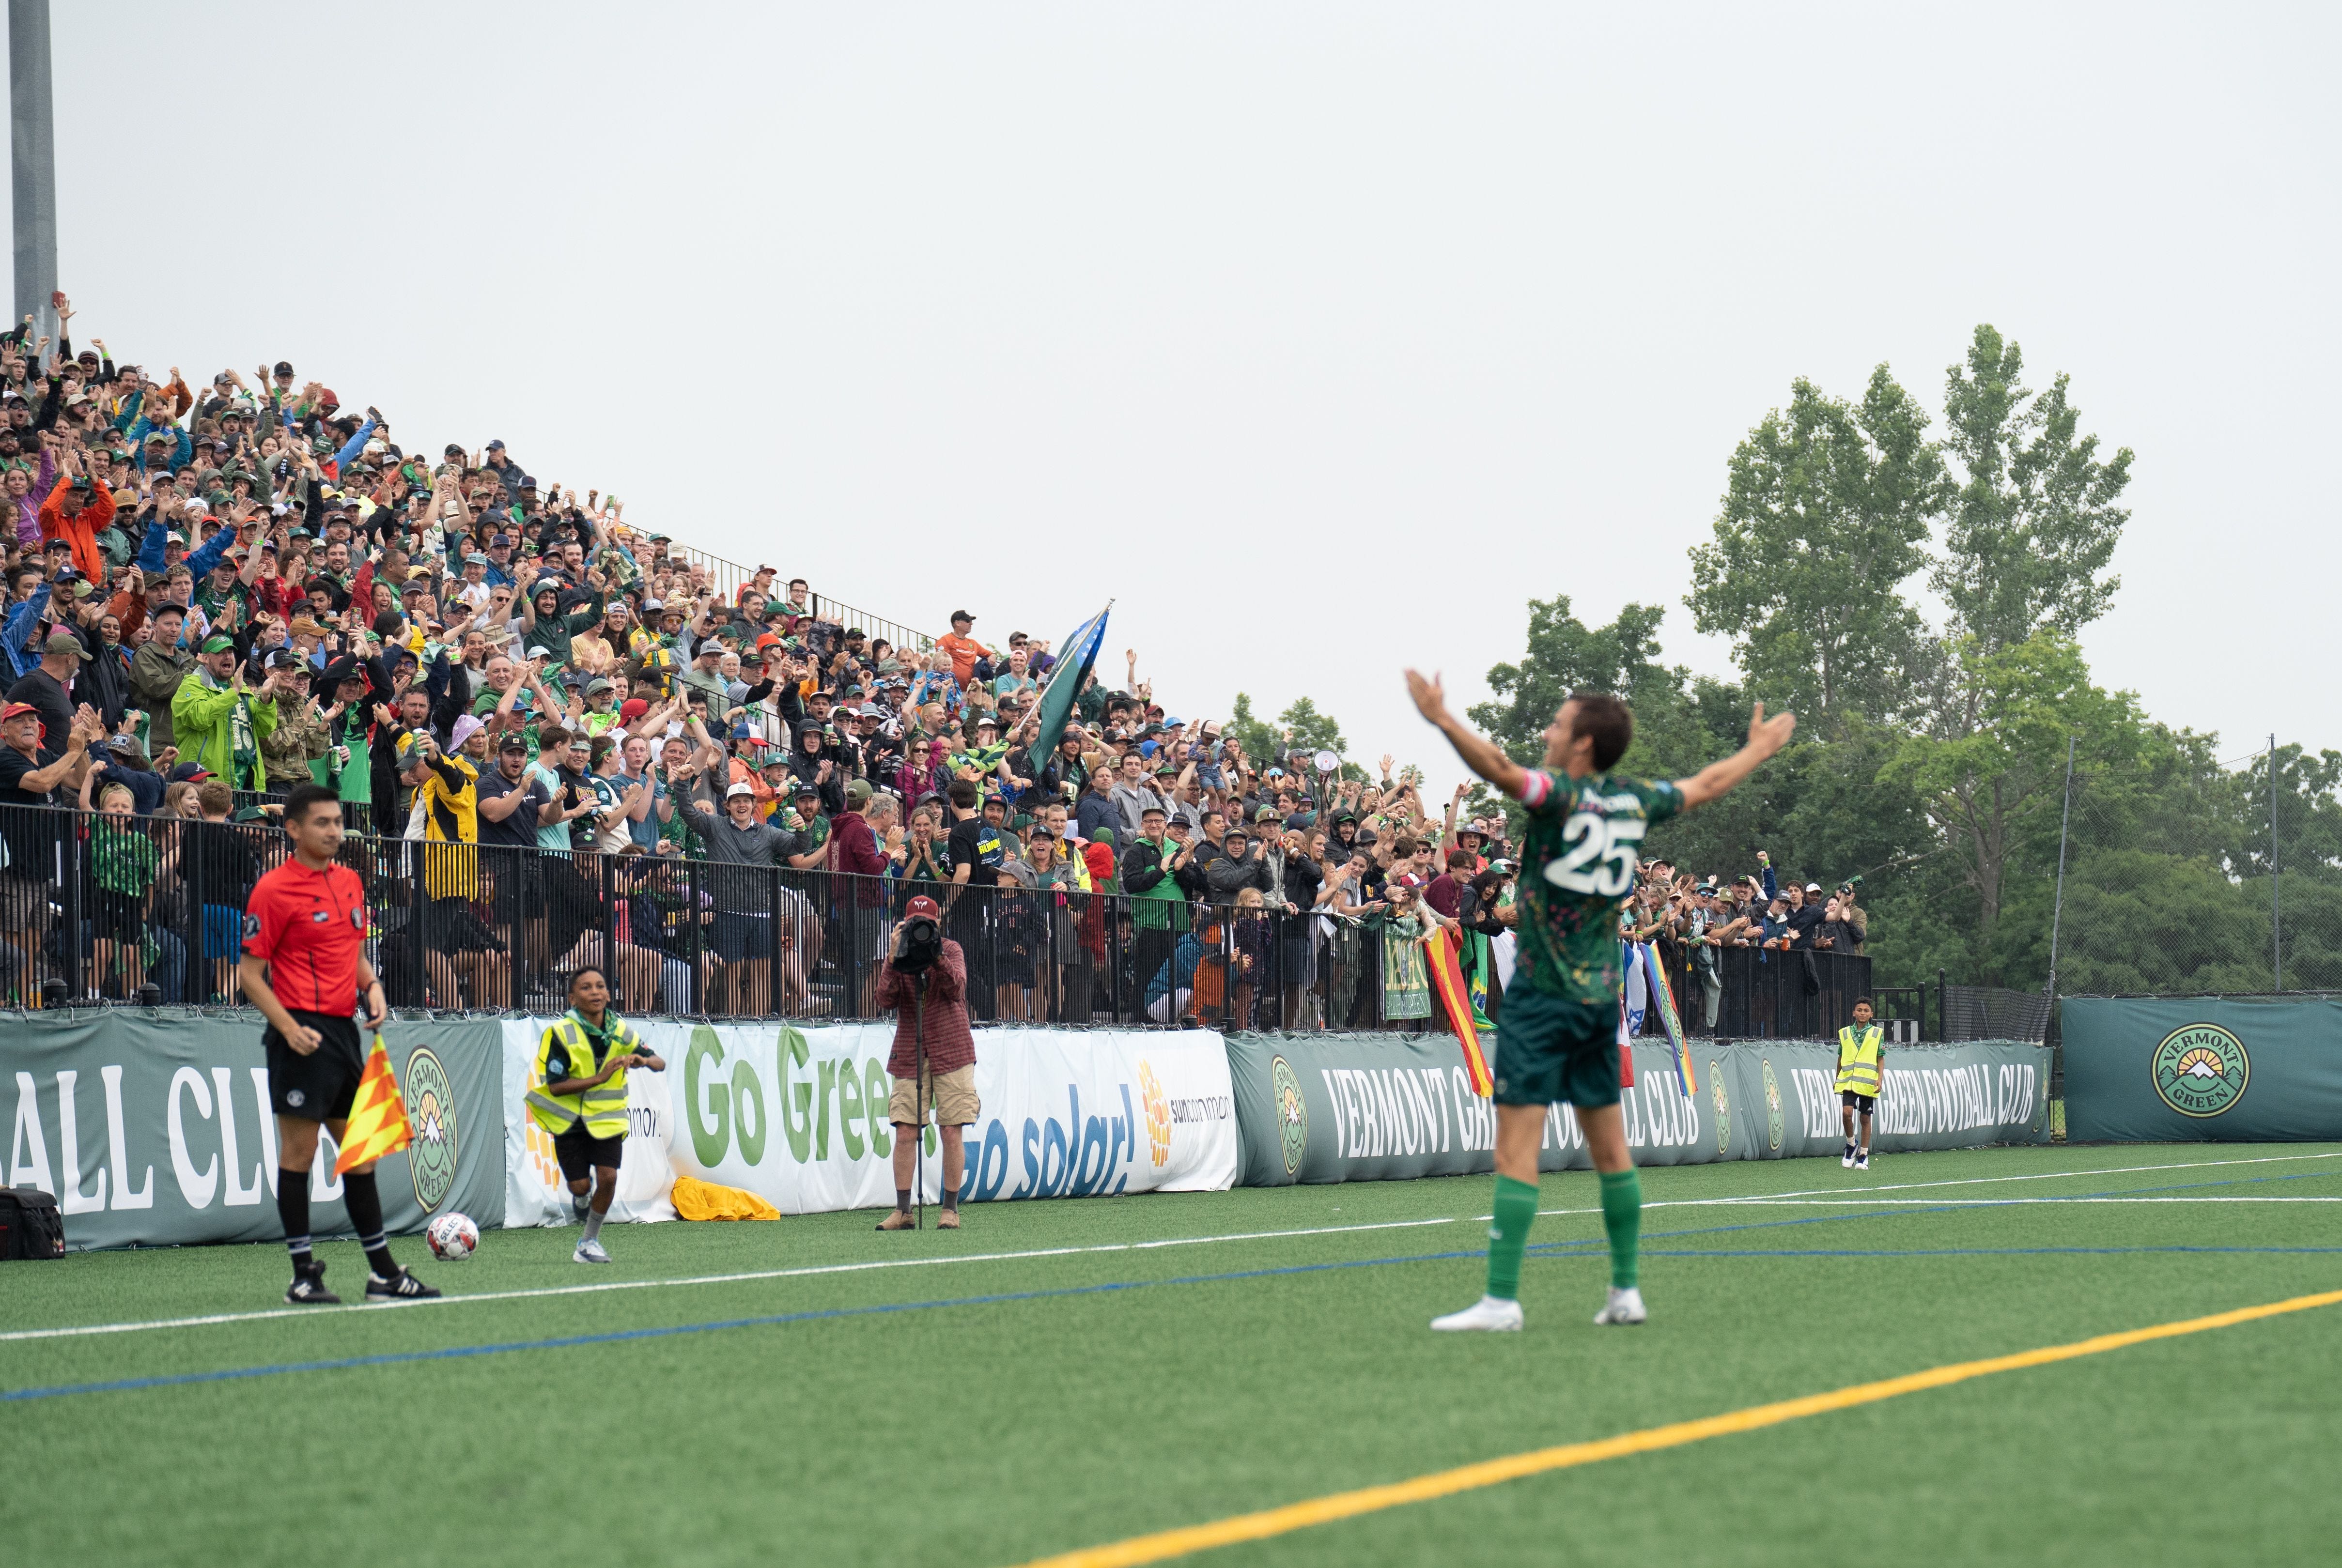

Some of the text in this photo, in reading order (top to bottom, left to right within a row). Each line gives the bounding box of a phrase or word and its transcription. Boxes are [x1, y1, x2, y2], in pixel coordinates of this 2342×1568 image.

[1544, 813, 1646, 896] 25
[2164, 1032, 2239, 1063] VERMONT
[410, 1064, 450, 1115] VERMONT
[685, 1025, 766, 1168] Go
[1277, 1068, 1302, 1103] VERMONT
[1791, 1069, 1872, 1138] VERM
[1878, 1069, 1926, 1134] GREEN
[1922, 1064, 1995, 1134] FOOTBALL
[1998, 1064, 2034, 1125] CLUB
[2173, 1088, 2229, 1108] GREEN
[1170, 1096, 1232, 1123] suncommon
[1321, 1068, 1448, 1158] VERMONT
[1644, 1070, 1699, 1147] CLUB
[0, 1065, 153, 1215] ALL
[1011, 1084, 1134, 1201] solar!
[1287, 1138, 1302, 1162] GREEN
[420, 1162, 449, 1198] GREEN
[440, 1217, 461, 1241] SELECT
